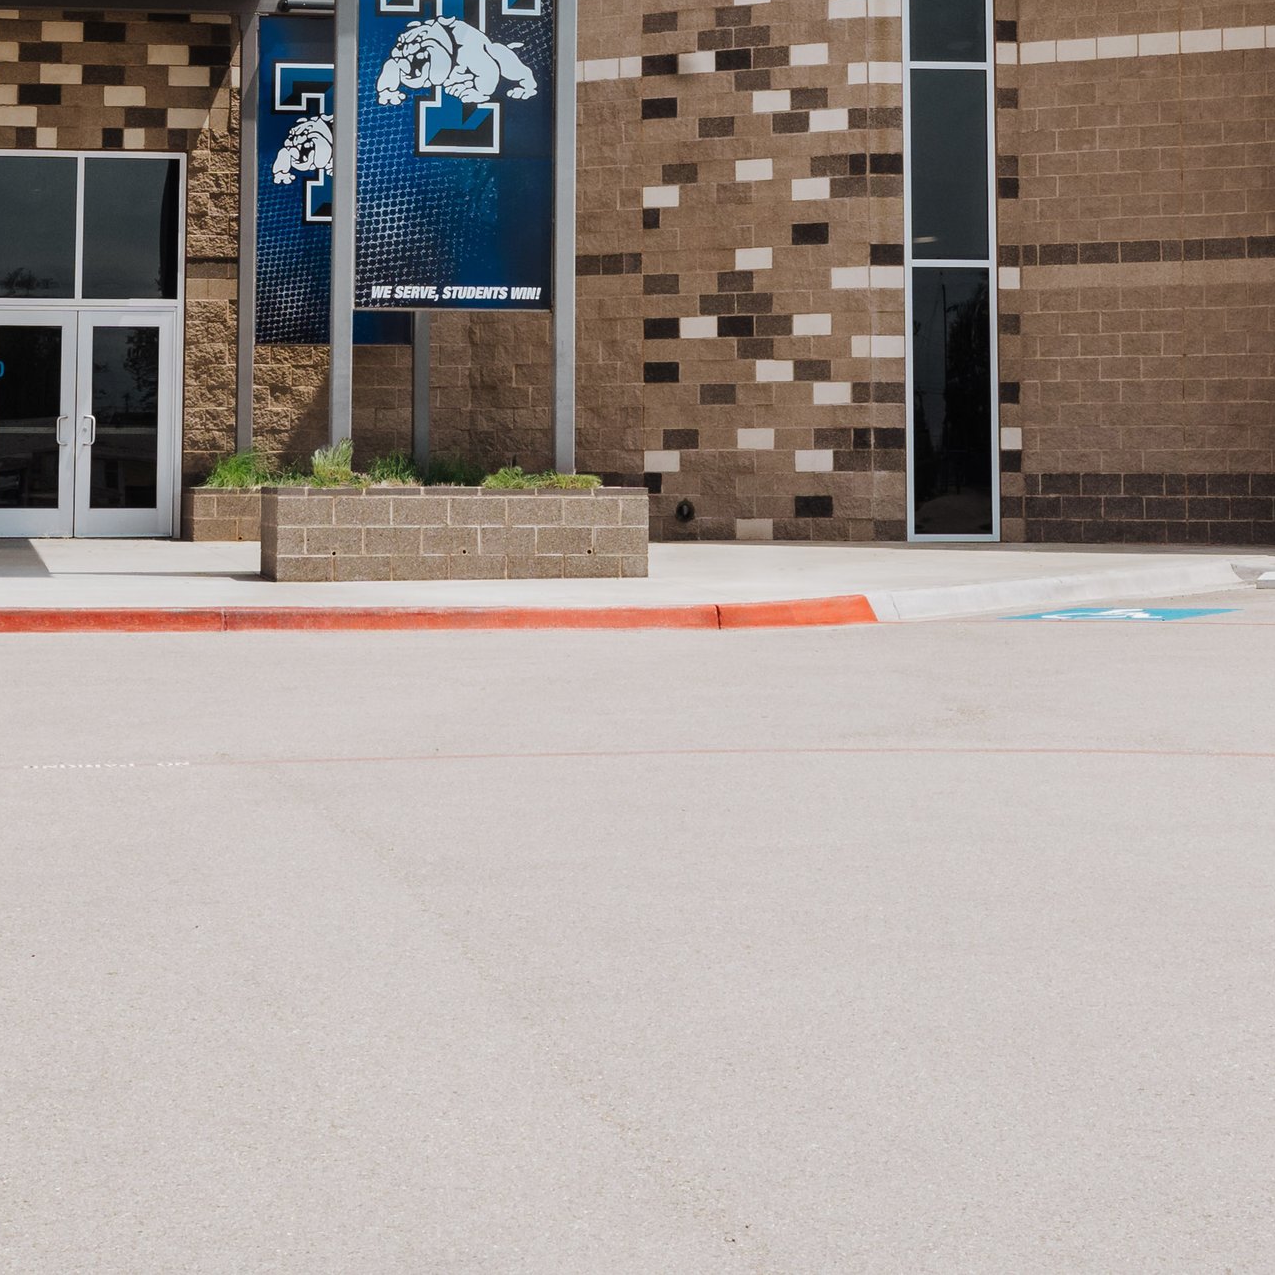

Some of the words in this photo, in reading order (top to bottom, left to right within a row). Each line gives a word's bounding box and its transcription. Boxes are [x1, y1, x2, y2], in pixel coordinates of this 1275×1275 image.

[371, 285, 393, 299] WE
[394, 285, 439, 302] SERVE,
[442, 286, 509, 300] STUDENTS
[510, 287, 541, 300] WIN!
